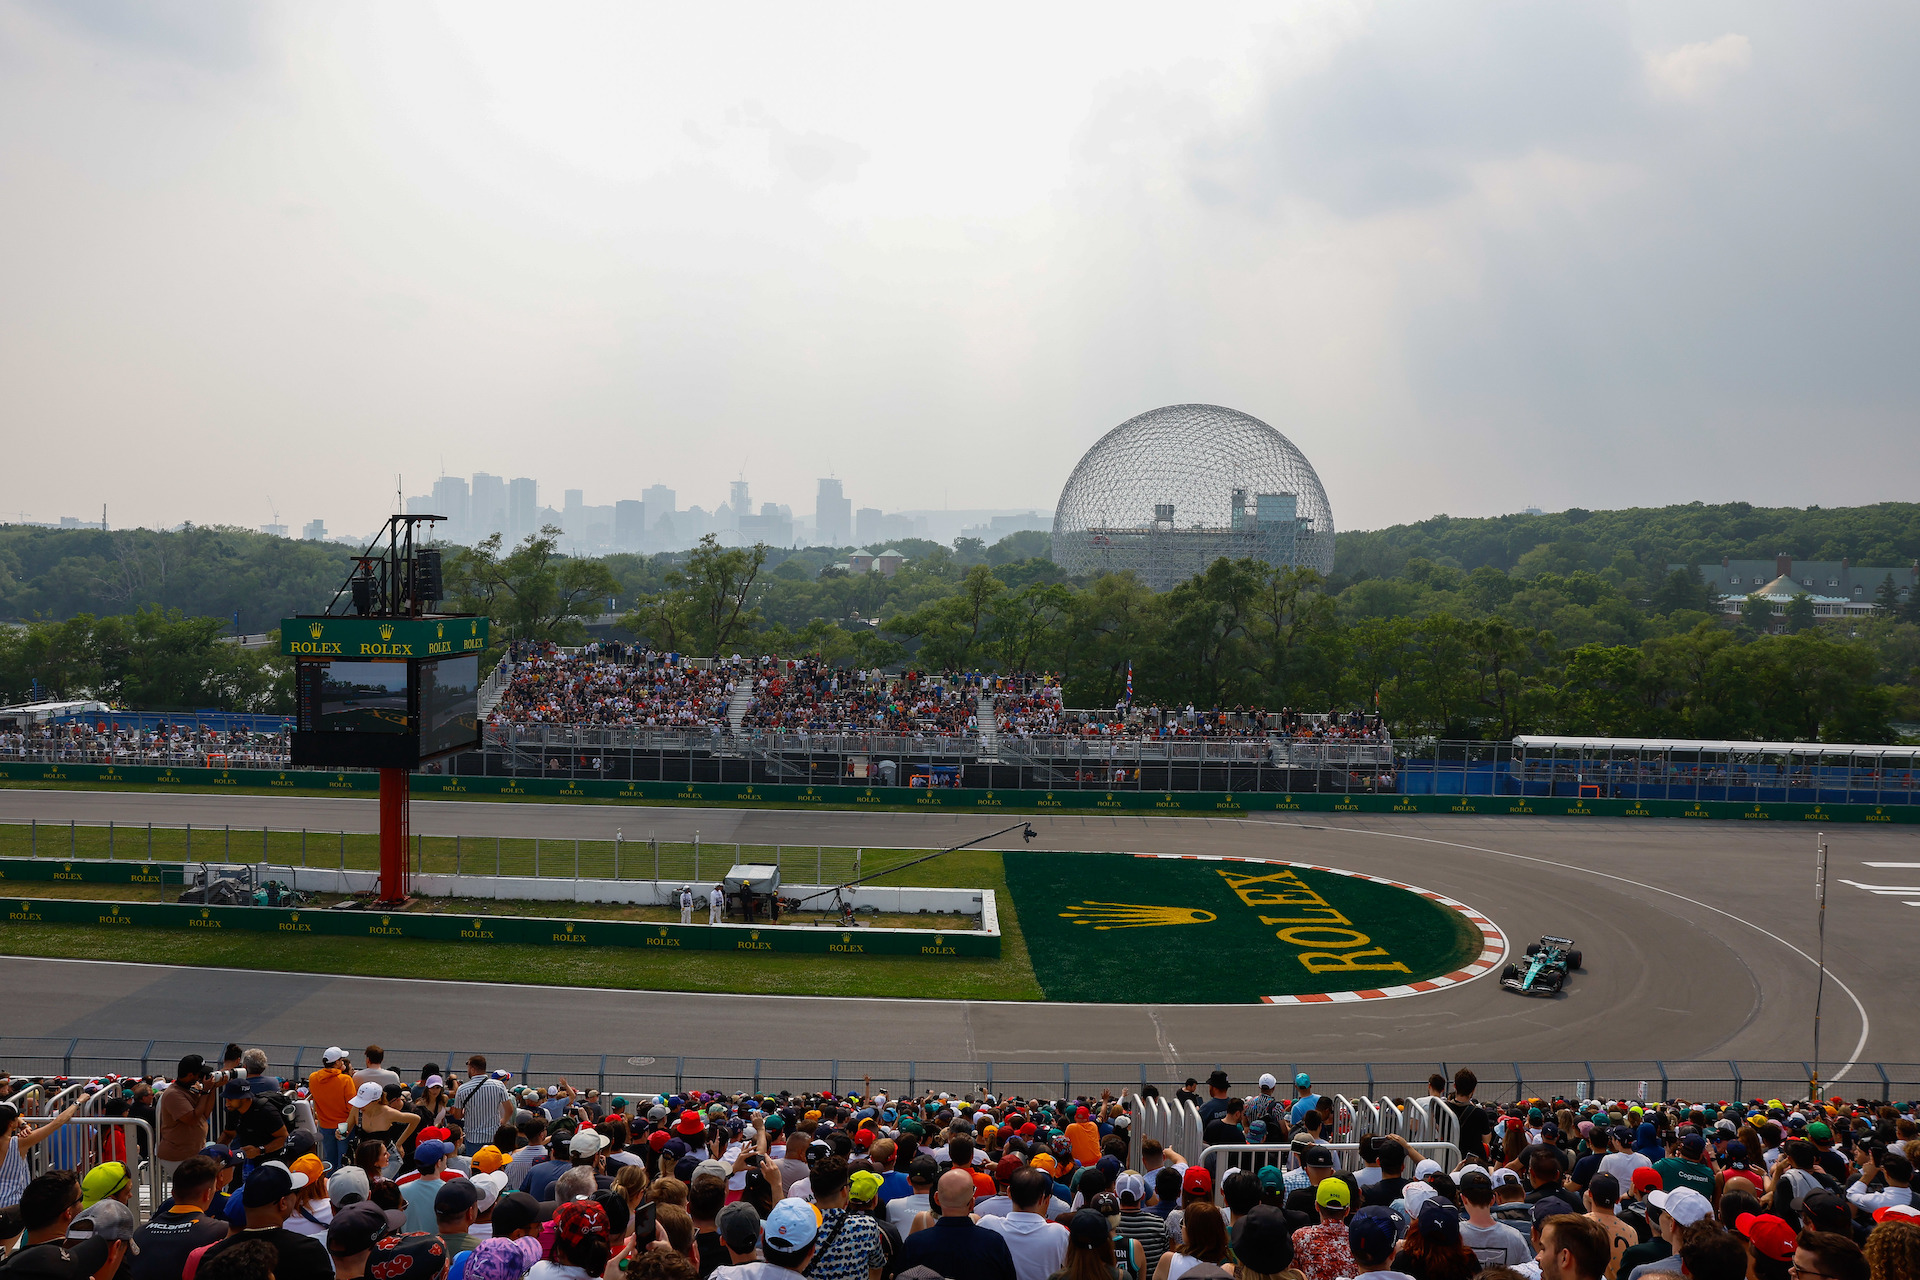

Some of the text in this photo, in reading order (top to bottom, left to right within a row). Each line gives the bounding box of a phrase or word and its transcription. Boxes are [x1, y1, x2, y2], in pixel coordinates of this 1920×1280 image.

[290, 641, 342, 654] ROLEX
[428, 641, 451, 654] ROLEX
[463, 638, 484, 650] ROLEX
[360, 643, 413, 656] ROLEX
[53, 872, 83, 881] ROLEX
[130, 874, 160, 883] ROLEX
[9, 912, 42, 921] ROLEX
[99, 915, 131, 925] ROLEX
[189, 919, 221, 928] ROLEX
[1216, 870, 1413, 974] ROLEX
[279, 923, 311, 932] ROLEX
[369, 926, 402, 936] ROLEX
[460, 930, 494, 939] ROLEX
[552, 934, 587, 943] ROLEX
[646, 937, 680, 947] ROLEX
[737, 941, 771, 950] ROLEX
[829, 943, 863, 953] ROLEX
[921, 946, 956, 955] ROLEX
[1678, 1171, 1709, 1183] Cognizant
[145, 1222, 192, 1230] McLaren
